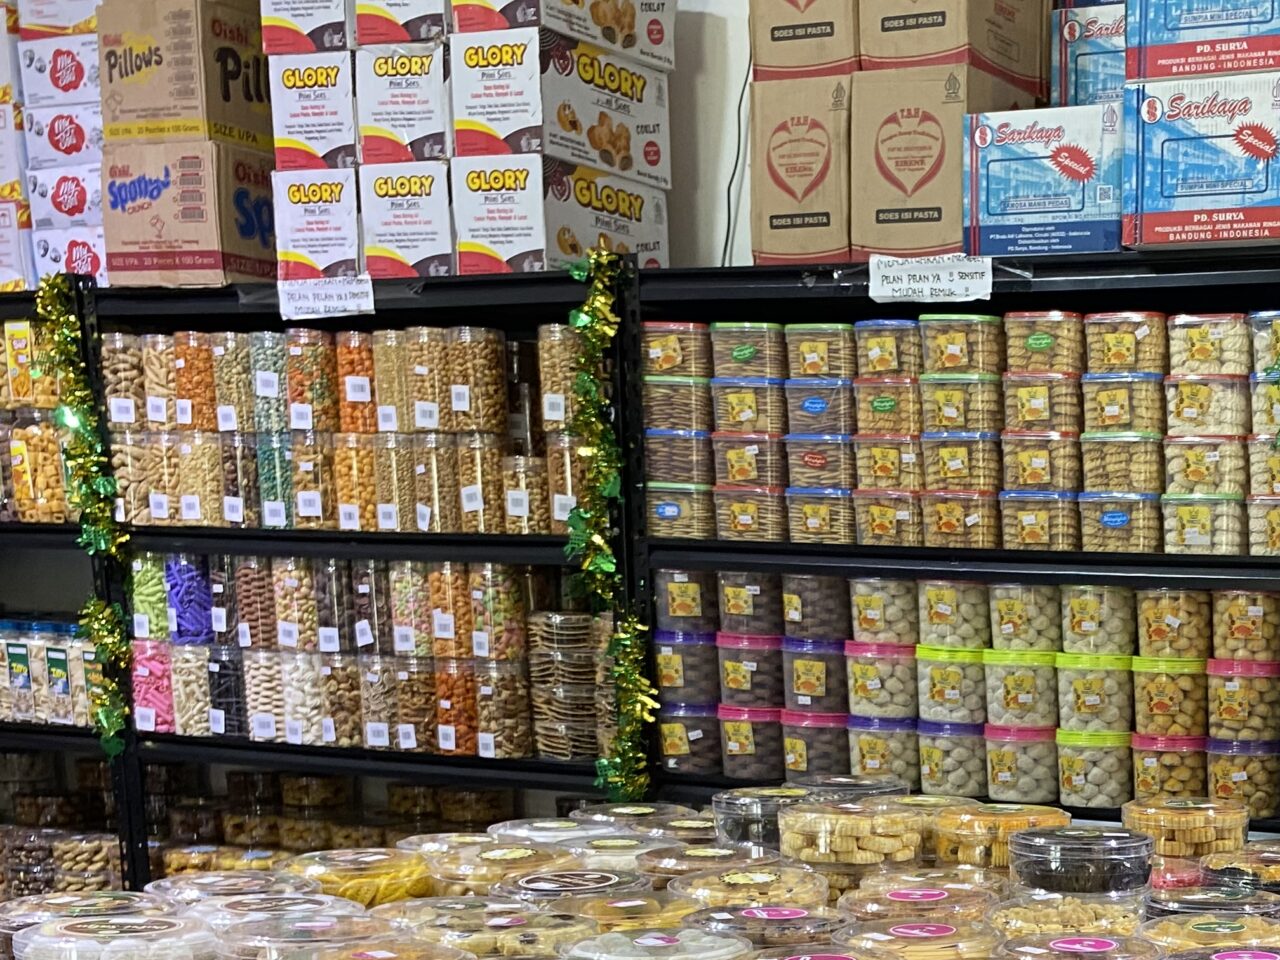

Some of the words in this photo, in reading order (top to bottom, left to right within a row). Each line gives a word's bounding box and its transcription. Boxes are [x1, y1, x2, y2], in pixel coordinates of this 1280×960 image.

[212, 19, 249, 45] Oishi
[773, 30, 793, 38] SOES
[795, 28, 806, 36] ISI
[807, 26, 832, 35] PASTA
[884, 20, 904, 28] SOES
[906, 18, 917, 26] ISI
[918, 16, 942, 25] PASTA
[464, 43, 527, 68] GLORY
[1215, 42, 1248, 50] SURYA
[105, 46, 163, 83] Pillows
[374, 55, 432, 76] GLORY
[1172, 64, 1215, 73] BANDUNG
[1223, 58, 1274, 68] INDONESIA
[282, 65, 340, 89] GLORY
[577, 53, 647, 103] GLORY
[1165, 91, 1252, 124] Sarikaya
[994, 122, 1064, 149] Sarikaya
[1238, 130, 1276, 154] Special
[1057, 152, 1090, 175] Special
[374, 175, 434, 198] GLORY
[466, 168, 529, 192] GLORY
[288, 182, 344, 204] GLORY
[574, 177, 644, 223] GLORY
[772, 218, 791, 226] SOES
[793, 217, 803, 225] ISI
[804, 216, 827, 224] PASTA
[914, 210, 939, 218] PASTA
[1194, 214, 1210, 223] PD.
[1212, 212, 1244, 221] SURYA
[1169, 232, 1212, 240] BANDUNG
[1219, 230, 1270, 238] INDONESIA
[881, 275, 902, 286] PELAN
[908, 274, 929, 284] PELAN
[931, 274, 940, 283] YA
[892, 288, 924, 298] MUDAH
